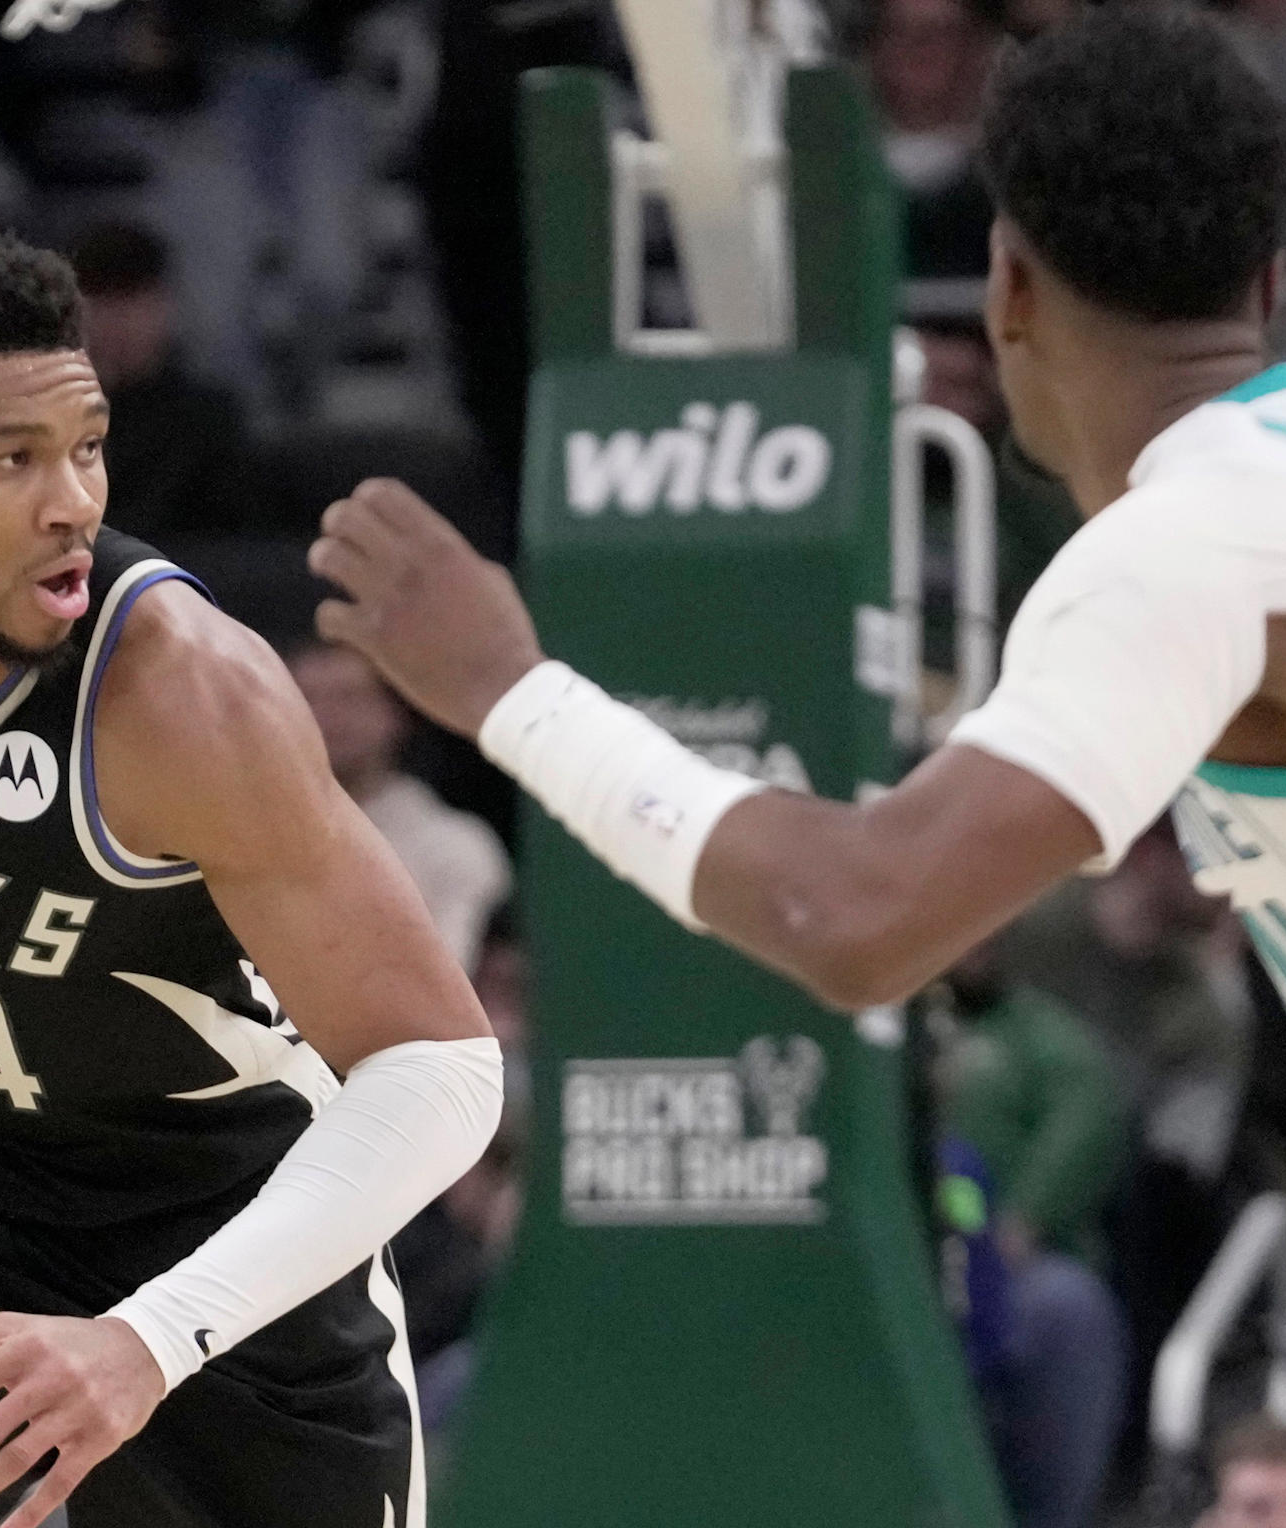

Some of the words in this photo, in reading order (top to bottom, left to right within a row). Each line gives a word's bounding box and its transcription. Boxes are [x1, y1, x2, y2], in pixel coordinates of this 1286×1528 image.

[564, 402, 833, 516] wilo
[563, 1072, 744, 1134] BUCKS
[680, 1136, 828, 1200] SHOP
